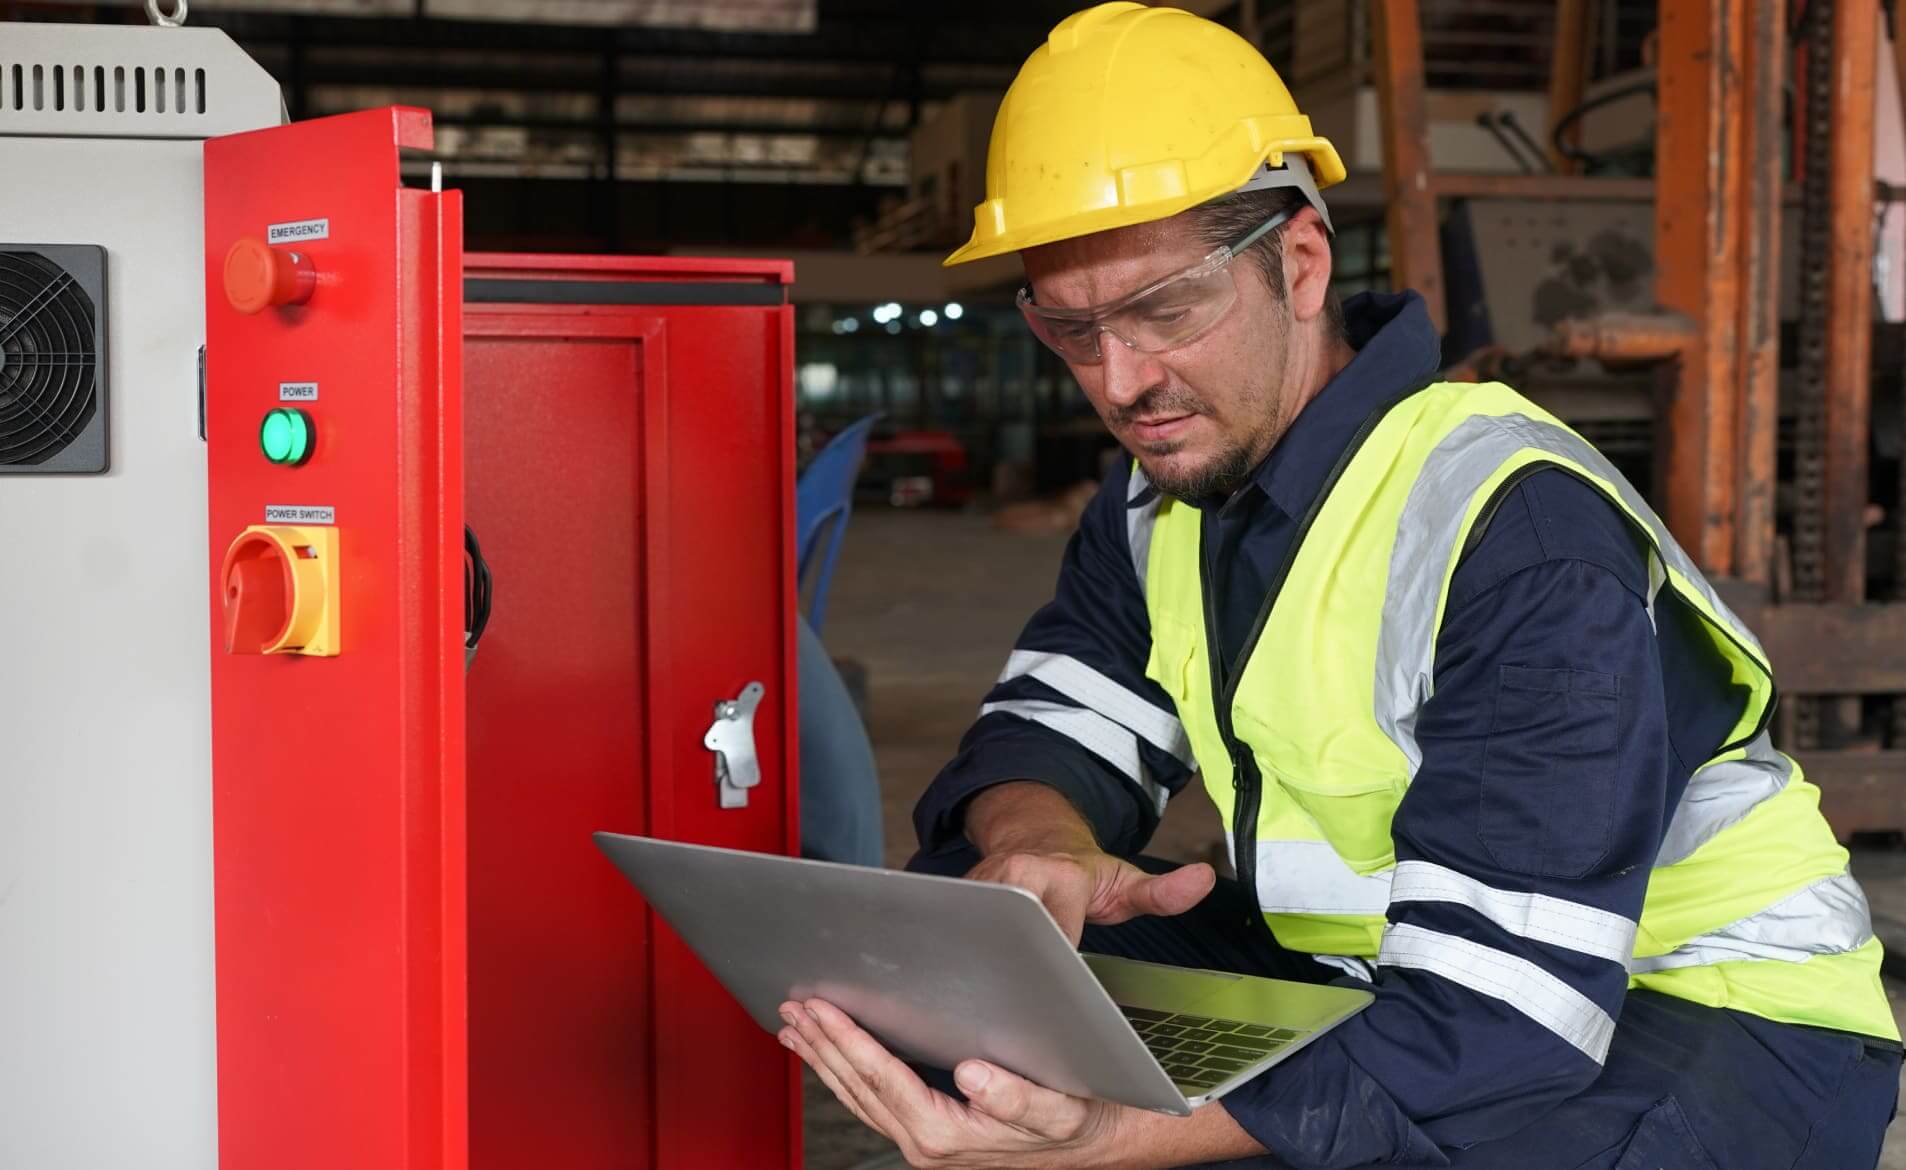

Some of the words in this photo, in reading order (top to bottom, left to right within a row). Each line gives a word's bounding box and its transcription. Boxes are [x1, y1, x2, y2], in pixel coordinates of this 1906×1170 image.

[271, 223, 326, 239] EMERGENCY
[282, 386, 314, 397] POWER
[266, 509, 298, 519] POWER
[299, 510, 332, 520] SWITCH
